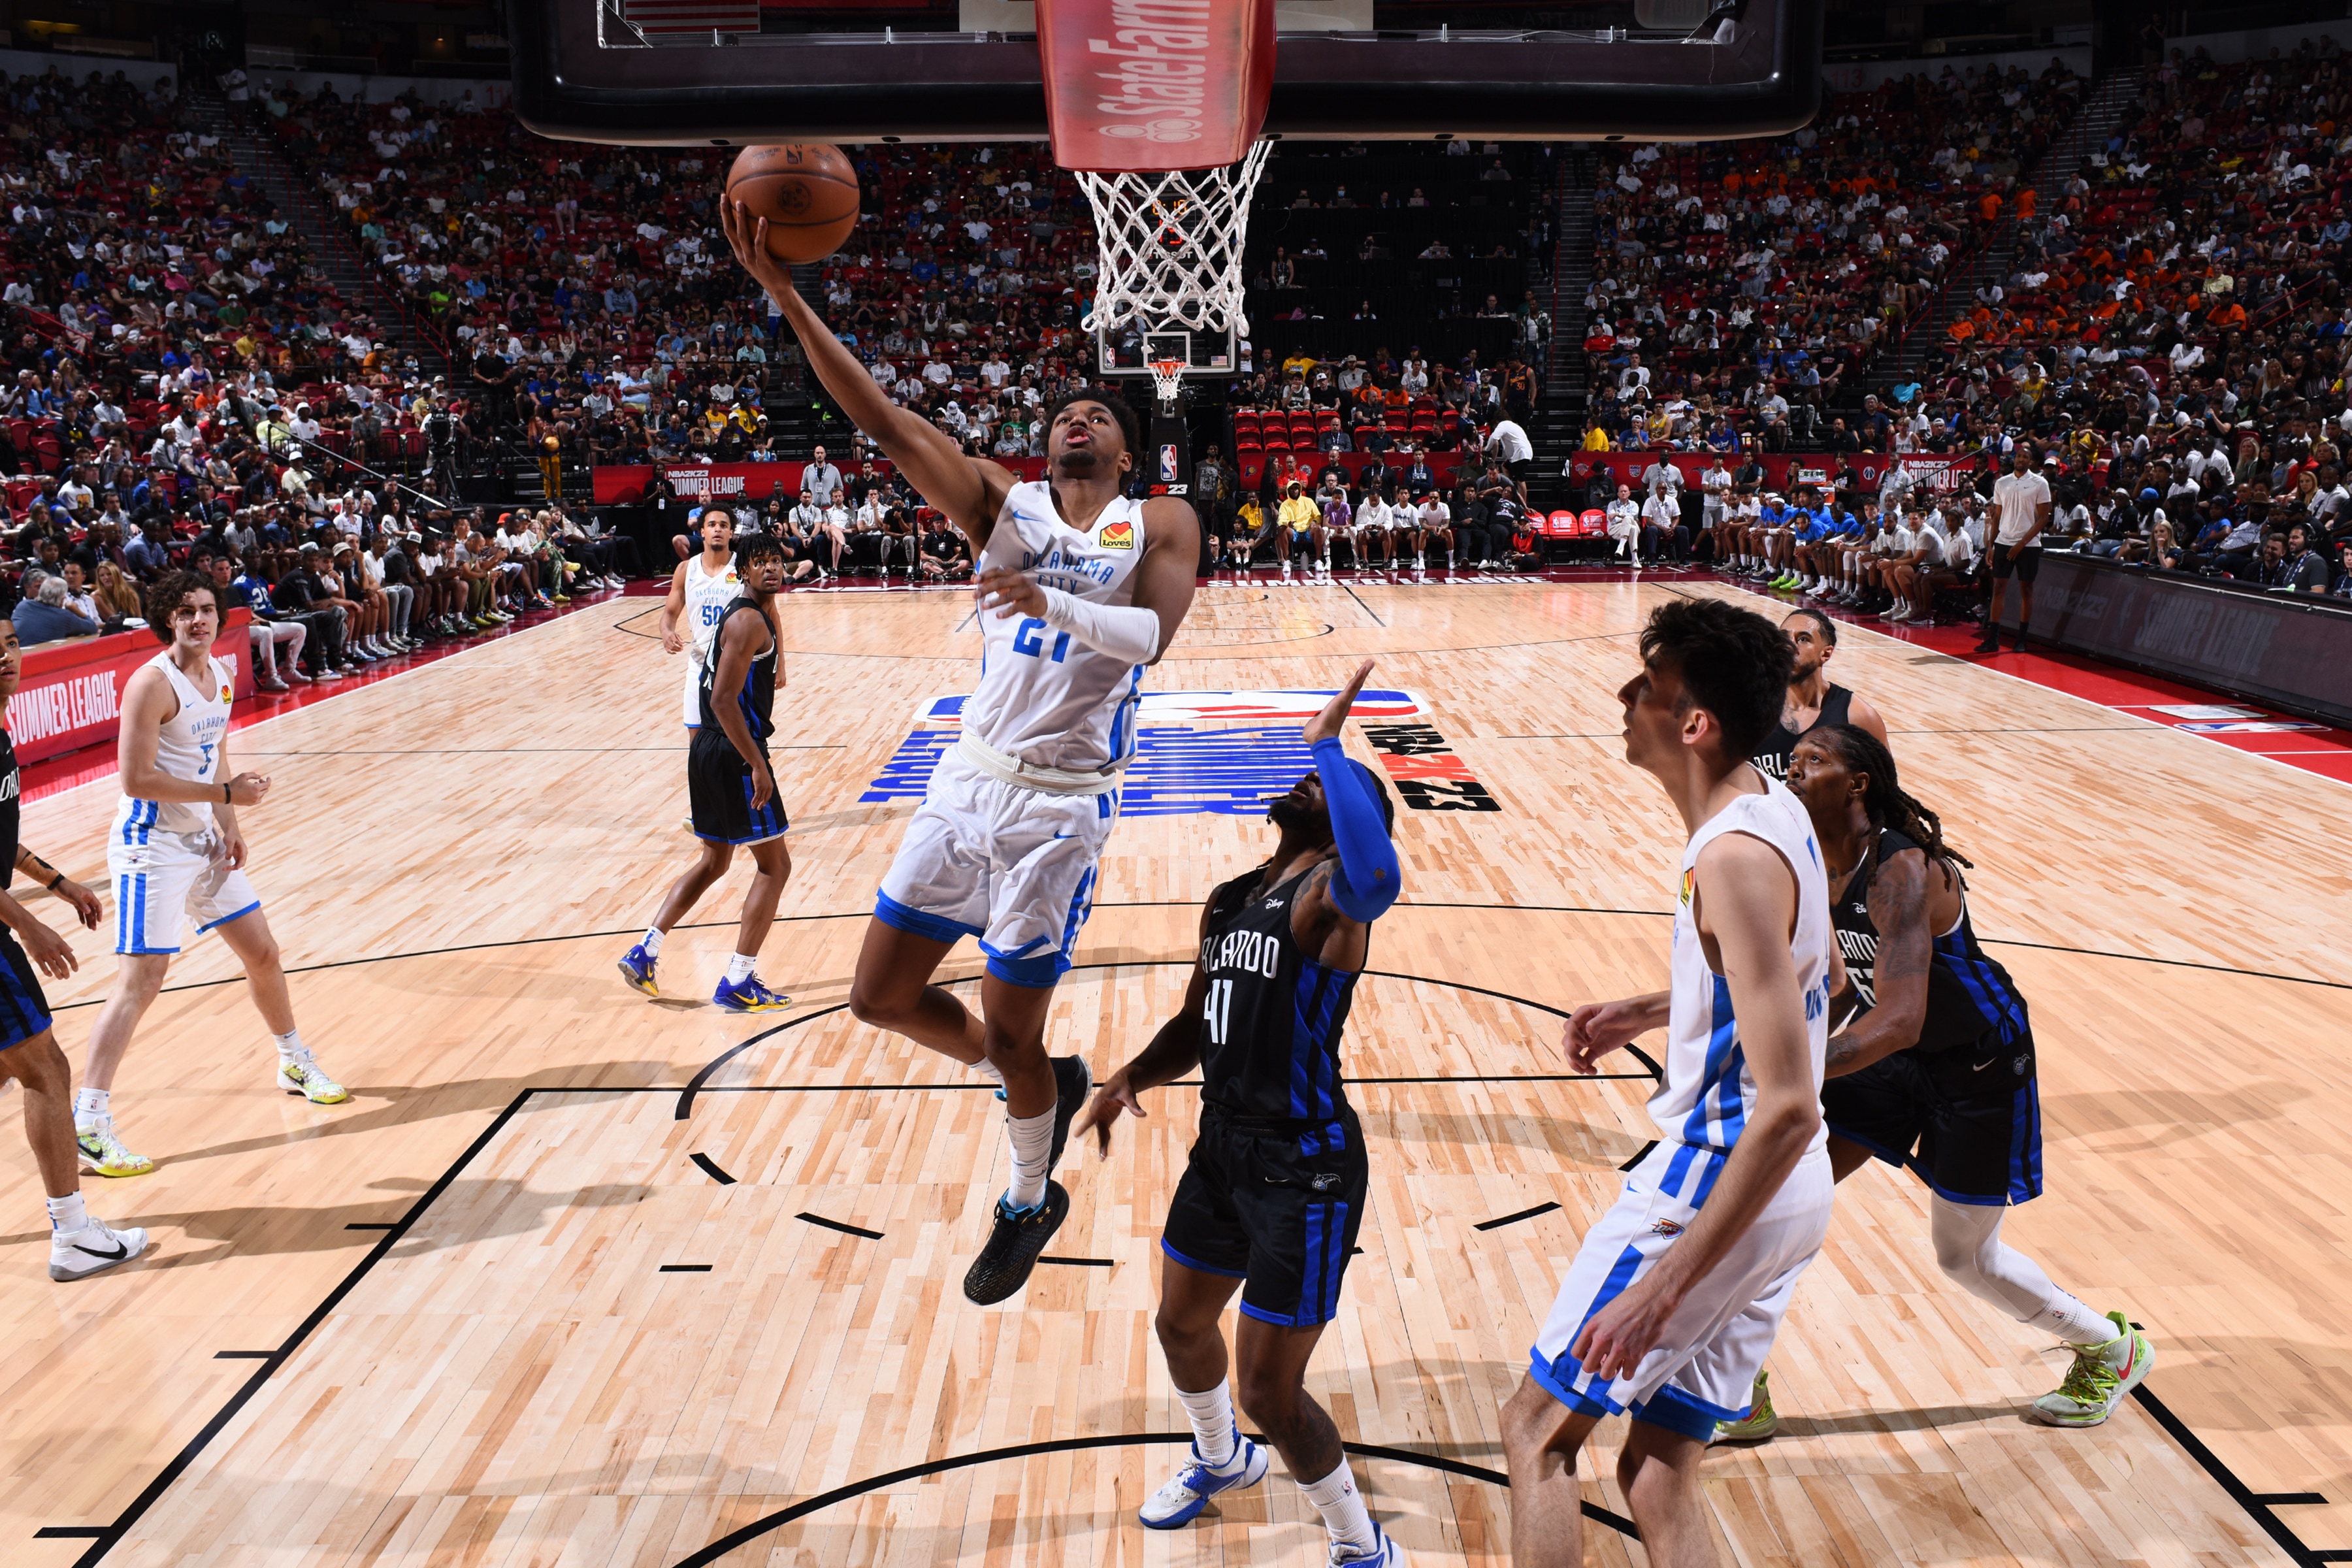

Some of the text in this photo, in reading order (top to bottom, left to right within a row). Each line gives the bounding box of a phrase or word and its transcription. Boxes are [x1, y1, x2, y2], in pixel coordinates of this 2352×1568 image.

[1831, 68, 1863, 89] 113
[1515, 382, 1525, 391] 30
[711, 476, 745, 495] LEAGUE
[1149, 484, 1188, 495] 2K23
[1023, 551, 1115, 585] OKLAHOMA
[695, 587, 729, 597] OKLAHOMA
[1037, 574, 1078, 593] CITY
[1206, 576, 1554, 587] SUMMER LEAGUE
[702, 606, 723, 627] 50
[1013, 617, 1071, 664] 21
[68, 670, 120, 728] LEAGUE
[1360, 724, 1503, 812] NBA2K23
[1201, 929, 1280, 979] RLANDO
[1203, 979, 1233, 1045] 41
